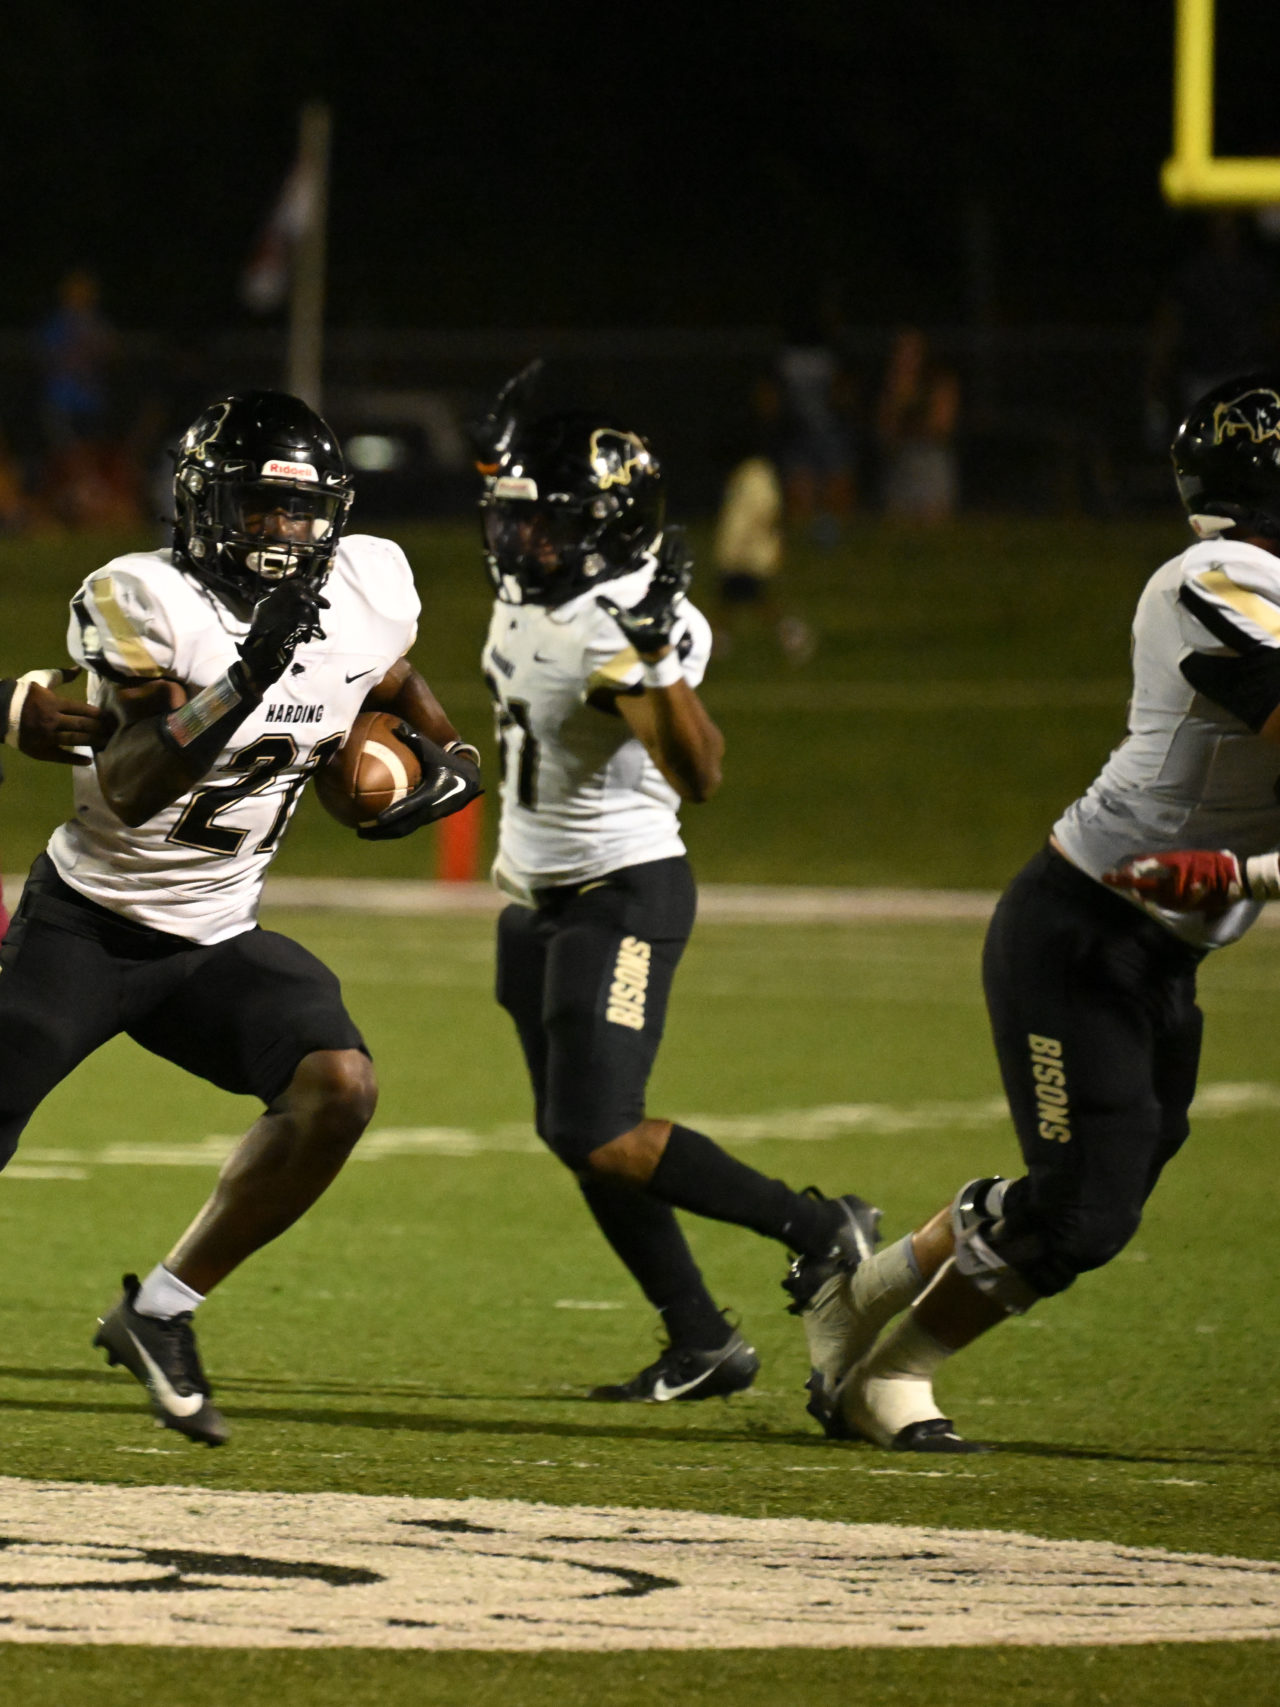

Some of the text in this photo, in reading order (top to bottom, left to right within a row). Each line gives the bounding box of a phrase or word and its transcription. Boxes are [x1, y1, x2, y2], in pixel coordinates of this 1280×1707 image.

[265, 703, 324, 723] HARDING
[165, 732, 347, 858] 21
[606, 935, 651, 1031] BISONS
[1028, 1032, 1071, 1144] BISONS
